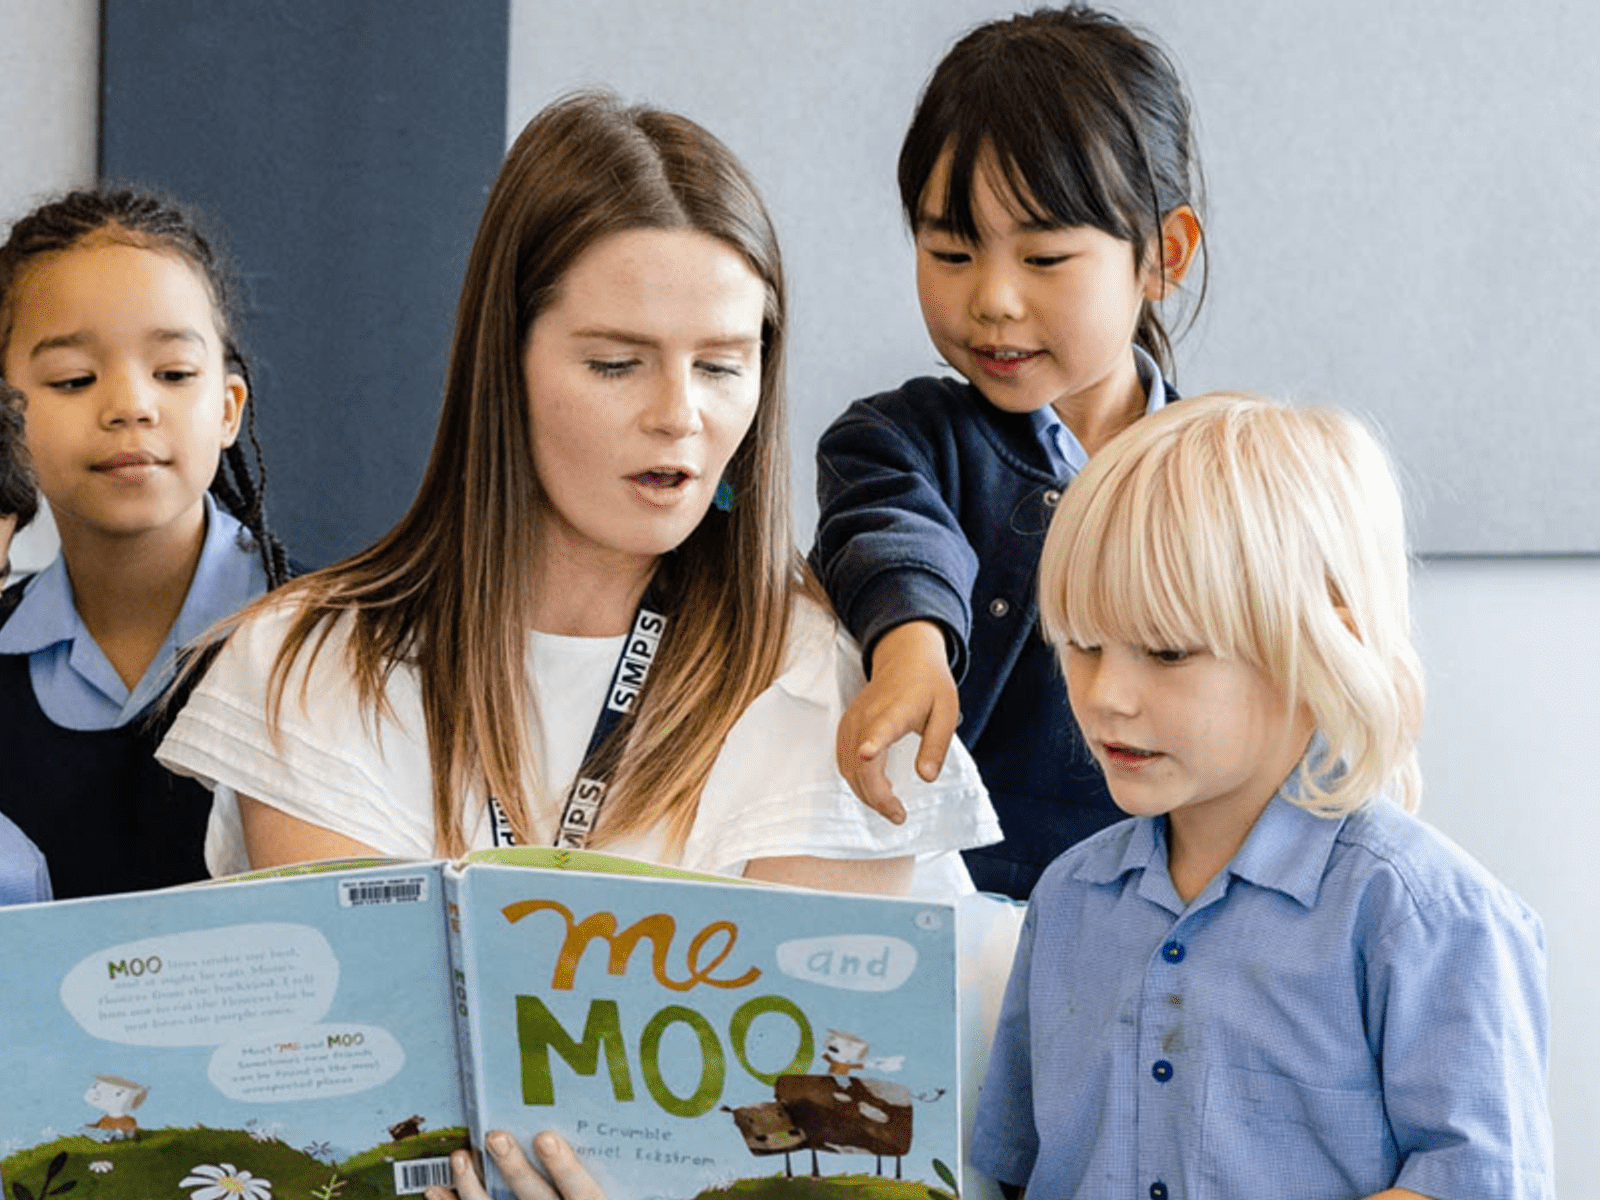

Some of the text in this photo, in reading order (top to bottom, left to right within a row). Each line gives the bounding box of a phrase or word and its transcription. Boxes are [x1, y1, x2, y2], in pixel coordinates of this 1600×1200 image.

[614, 615, 662, 707] SMPS
[107, 955, 162, 980] MOO
[806, 946, 890, 980] and
[327, 1032, 365, 1049] MOO
[515, 994, 815, 1119] MOO
[576, 1120, 673, 1141] P Crumble
